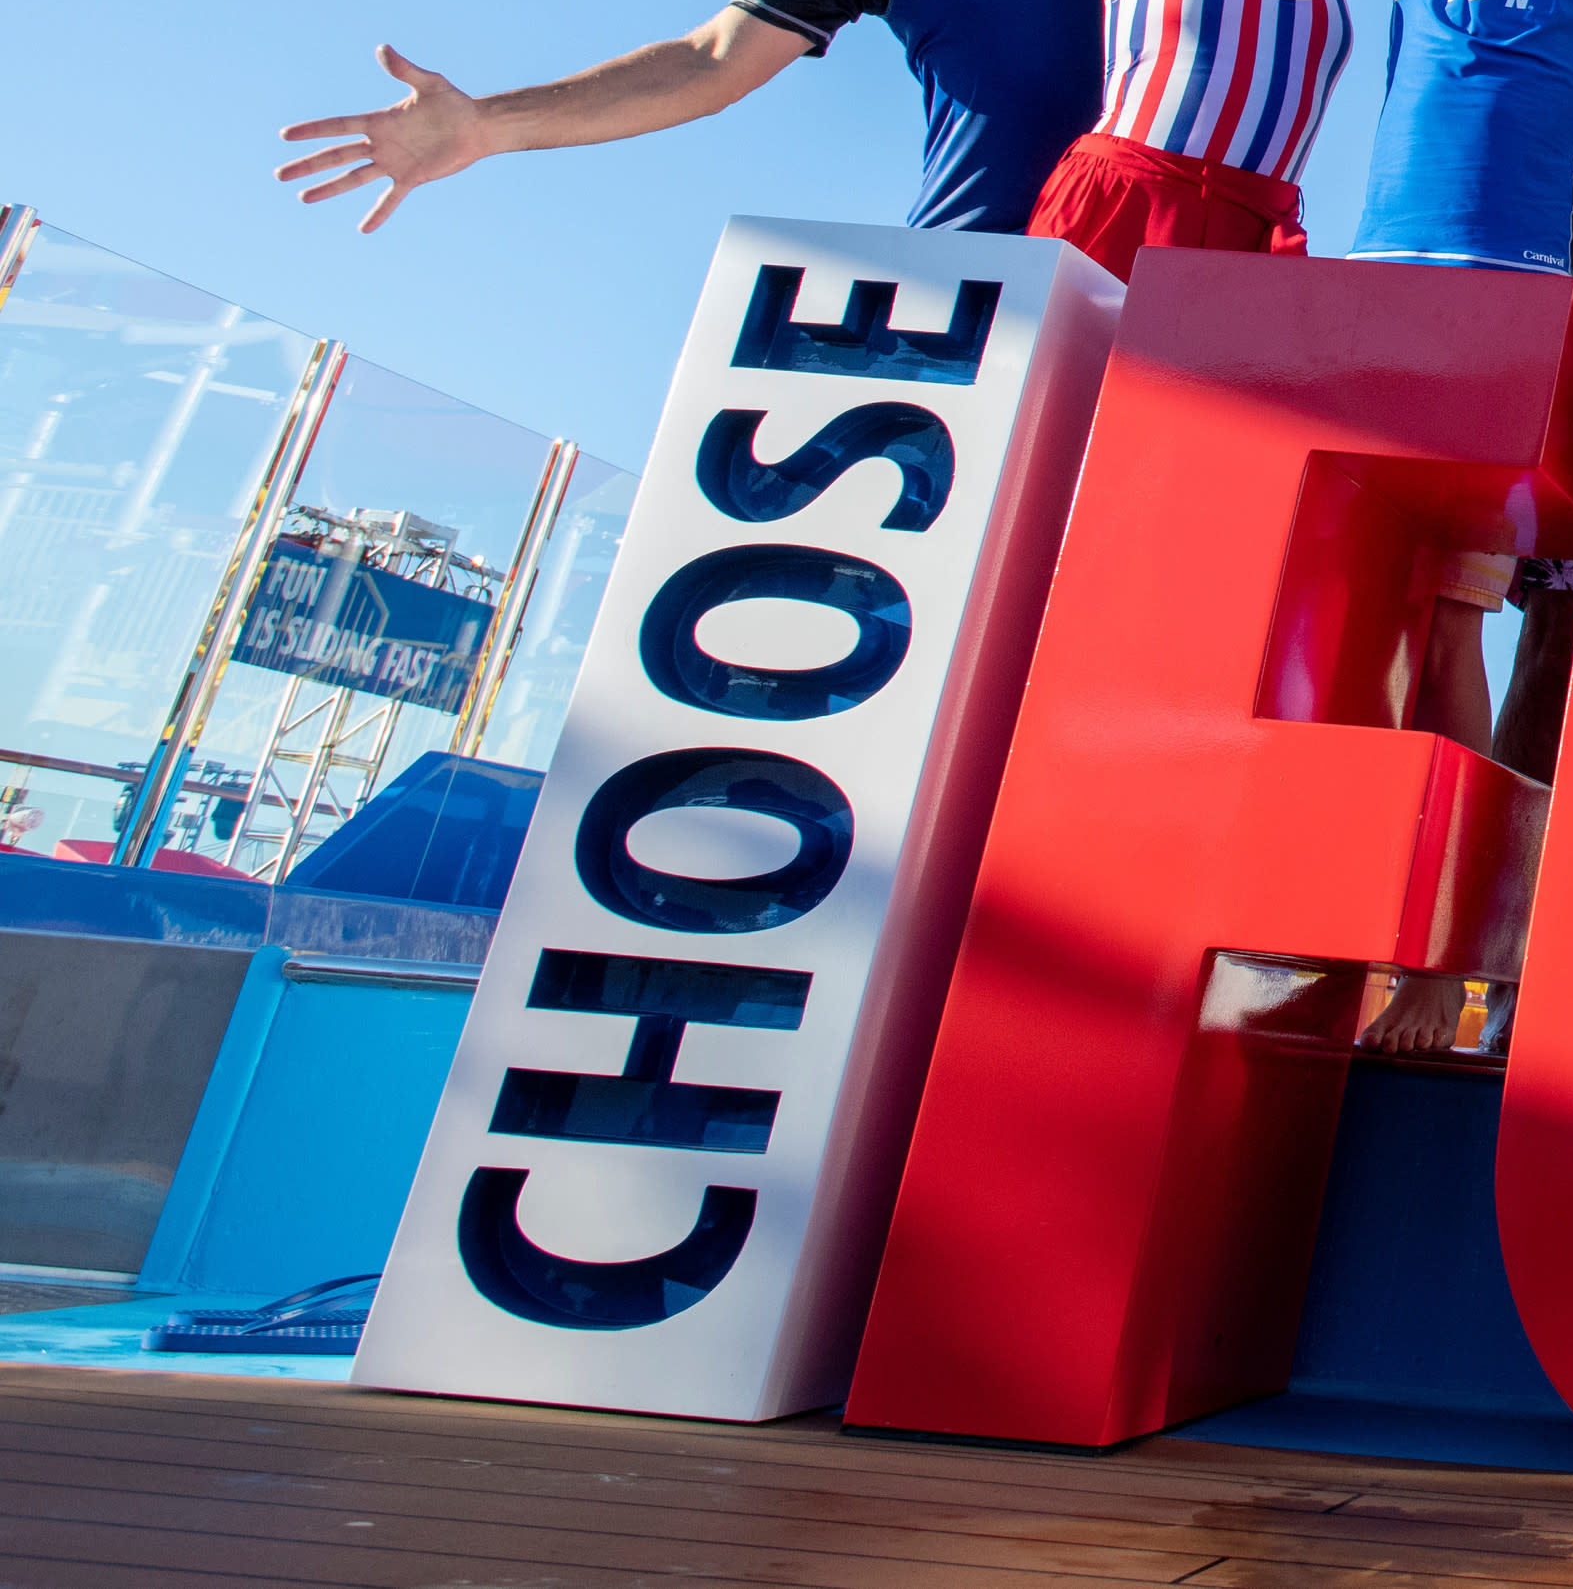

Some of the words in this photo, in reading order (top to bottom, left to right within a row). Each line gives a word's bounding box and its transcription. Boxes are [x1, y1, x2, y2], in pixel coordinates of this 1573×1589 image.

[1523, 250, 1565, 268] Carnival
[266, 555, 328, 607] FUN
[247, 606, 282, 650] IS
[278, 615, 384, 676] SLIDING
[381, 640, 441, 690] FAST
[456, 263, 1004, 1332] CHOOSE
